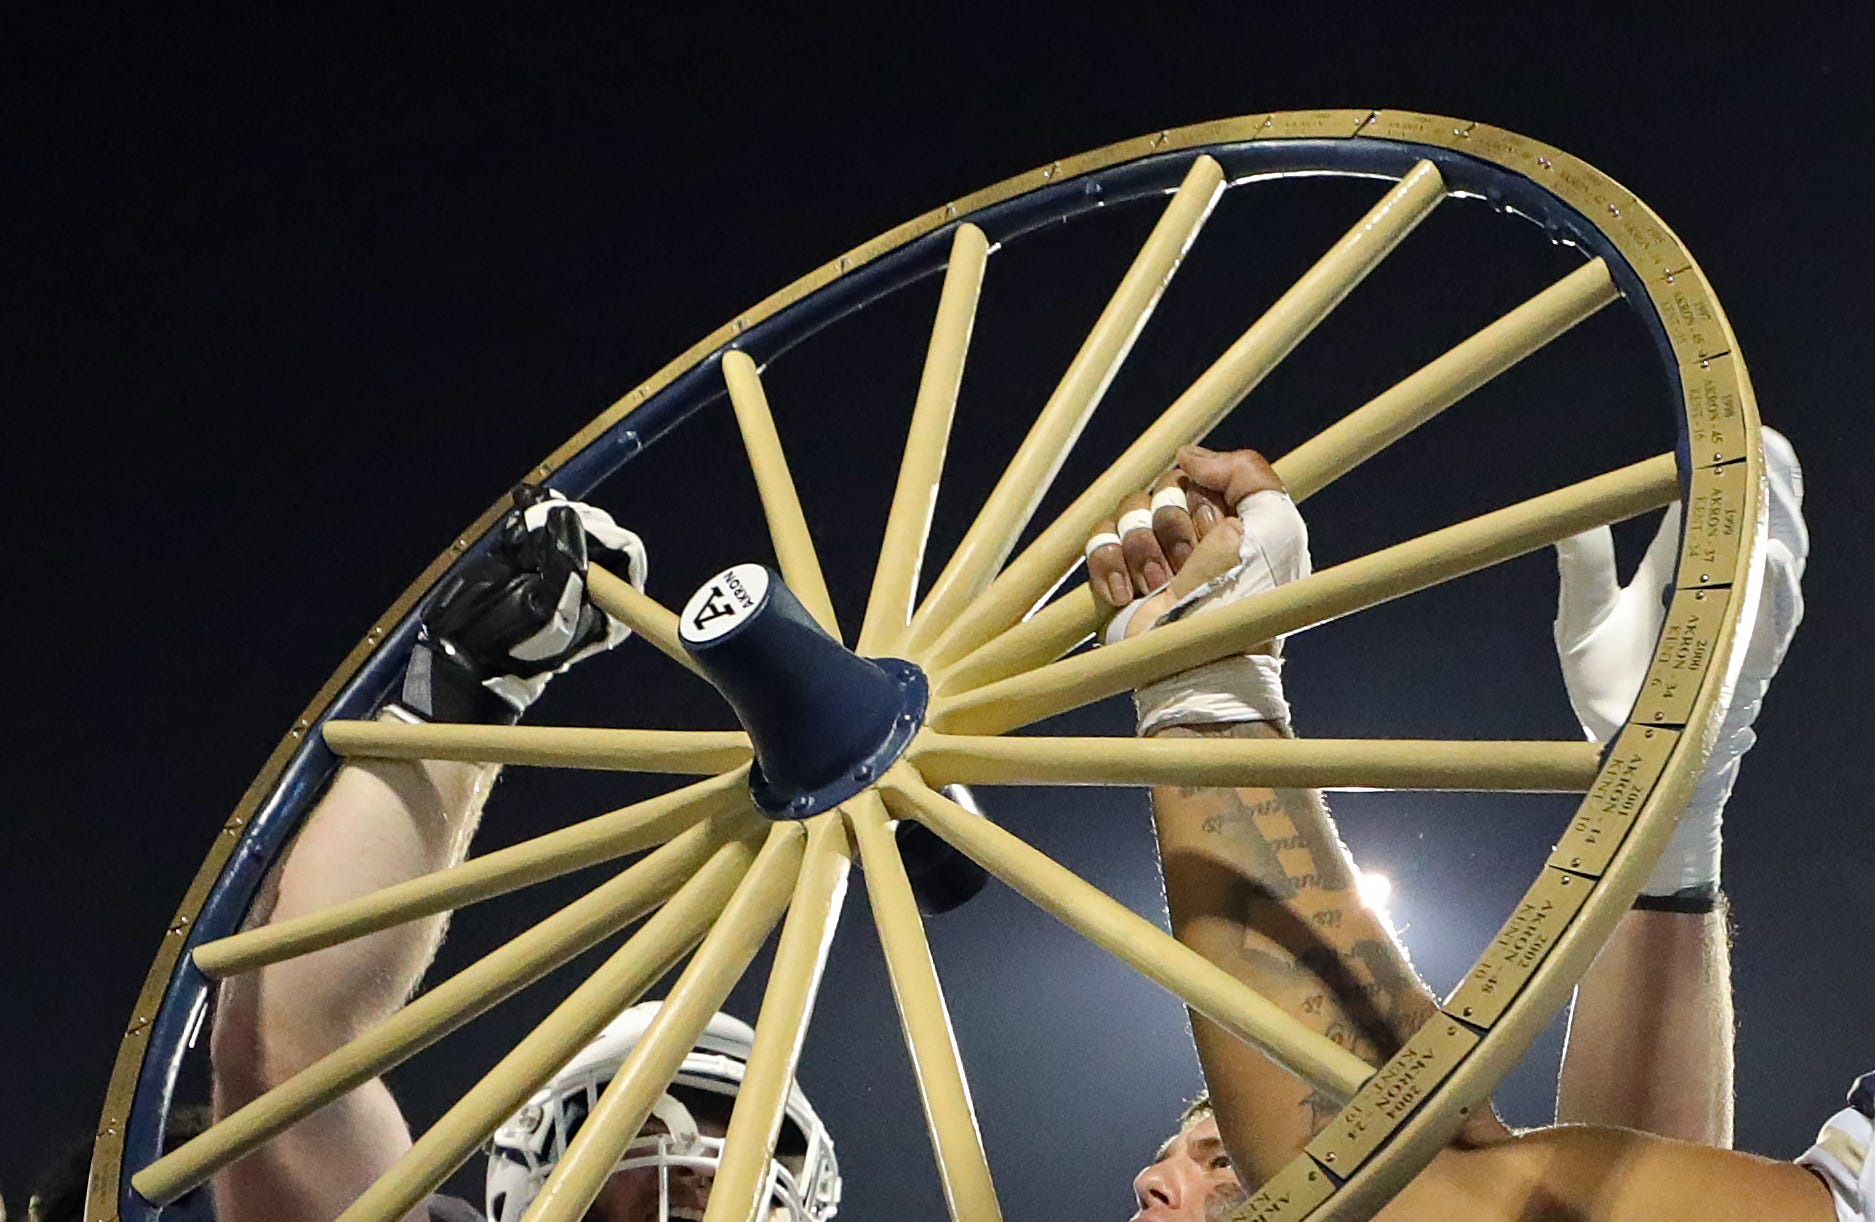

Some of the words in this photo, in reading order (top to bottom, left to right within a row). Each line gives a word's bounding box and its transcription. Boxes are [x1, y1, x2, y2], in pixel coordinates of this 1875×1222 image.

[1703, 377, 1720, 421] AKRON
[1711, 429, 1723, 444] 45
[1690, 495, 1707, 532] KENT
[1705, 486, 1723, 537] AKRON
[1702, 549, 1715, 563] 37
[693, 586, 736, 630] A
[723, 571, 754, 608] AKRON
[1657, 625, 1681, 662] KENT
[1670, 613, 1702, 669] AKRON
[1686, 639, 1709, 670] 2000
[1649, 678, 1663, 686] 6
[1661, 683, 1677, 697] 34
[1590, 758, 1625, 801] KENT
[1600, 753, 1645, 814] AKRON
[1616, 784, 1643, 816] 2001
[1573, 816, 1591, 832] 10
[1583, 828, 1602, 844] 14
[1496, 903, 1536, 947] KENT
[1502, 899, 1556, 963] AKRON
[1515, 933, 1549, 969] 2002
[1472, 962, 1492, 980] 10
[1479, 974, 1501, 994] 48
[1369, 1047, 1418, 1094] KENT
[1373, 1047, 1438, 1111] AKRON
[1384, 1083, 1422, 1120] 2004
[1344, 1120, 1368, 1141] 24
